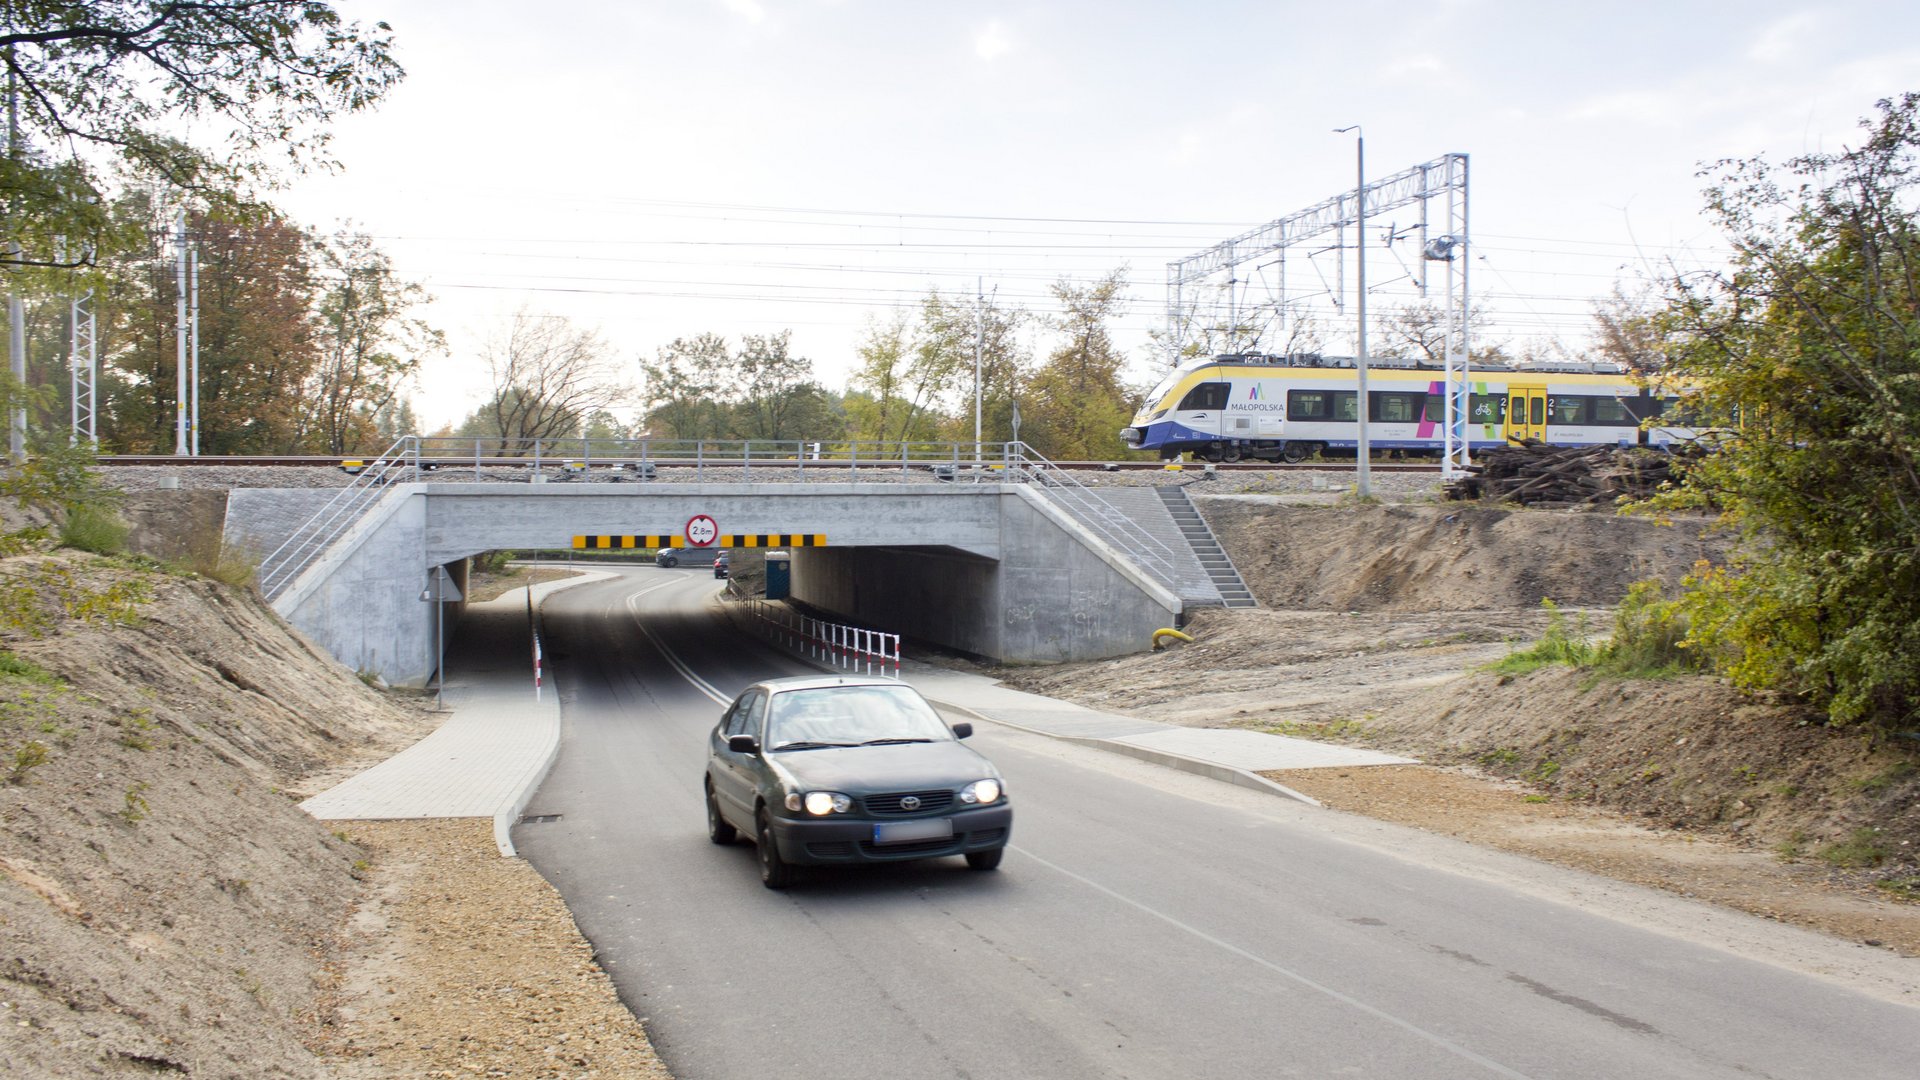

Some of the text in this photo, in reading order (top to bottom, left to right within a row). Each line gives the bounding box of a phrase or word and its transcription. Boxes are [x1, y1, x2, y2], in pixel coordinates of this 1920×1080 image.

[1500, 398, 1507, 407] 2
[1548, 399, 1555, 407] 2
[1231, 403, 1284, 411] MAŁOPOLSKA
